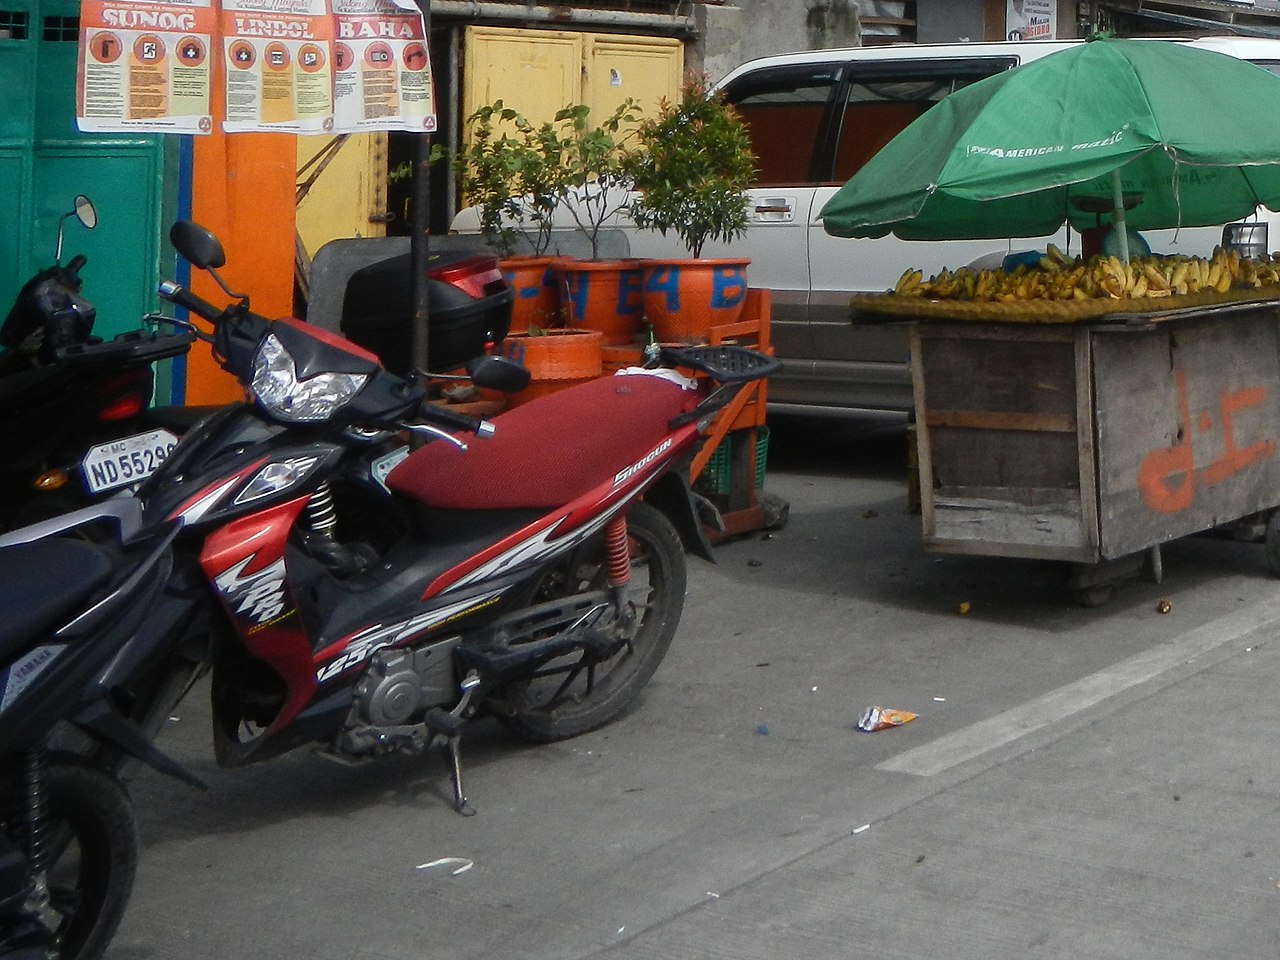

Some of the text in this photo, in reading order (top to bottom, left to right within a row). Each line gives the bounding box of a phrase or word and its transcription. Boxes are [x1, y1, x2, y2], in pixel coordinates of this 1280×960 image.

[103, 8, 196, 30] SUNOG
[236, 18, 314, 39] LINDOL
[339, 21, 414, 39] BAHA
[988, 144, 1064, 158] AMERICAN
[709, 264, 748, 310] B
[111, 442, 127, 453] MC
